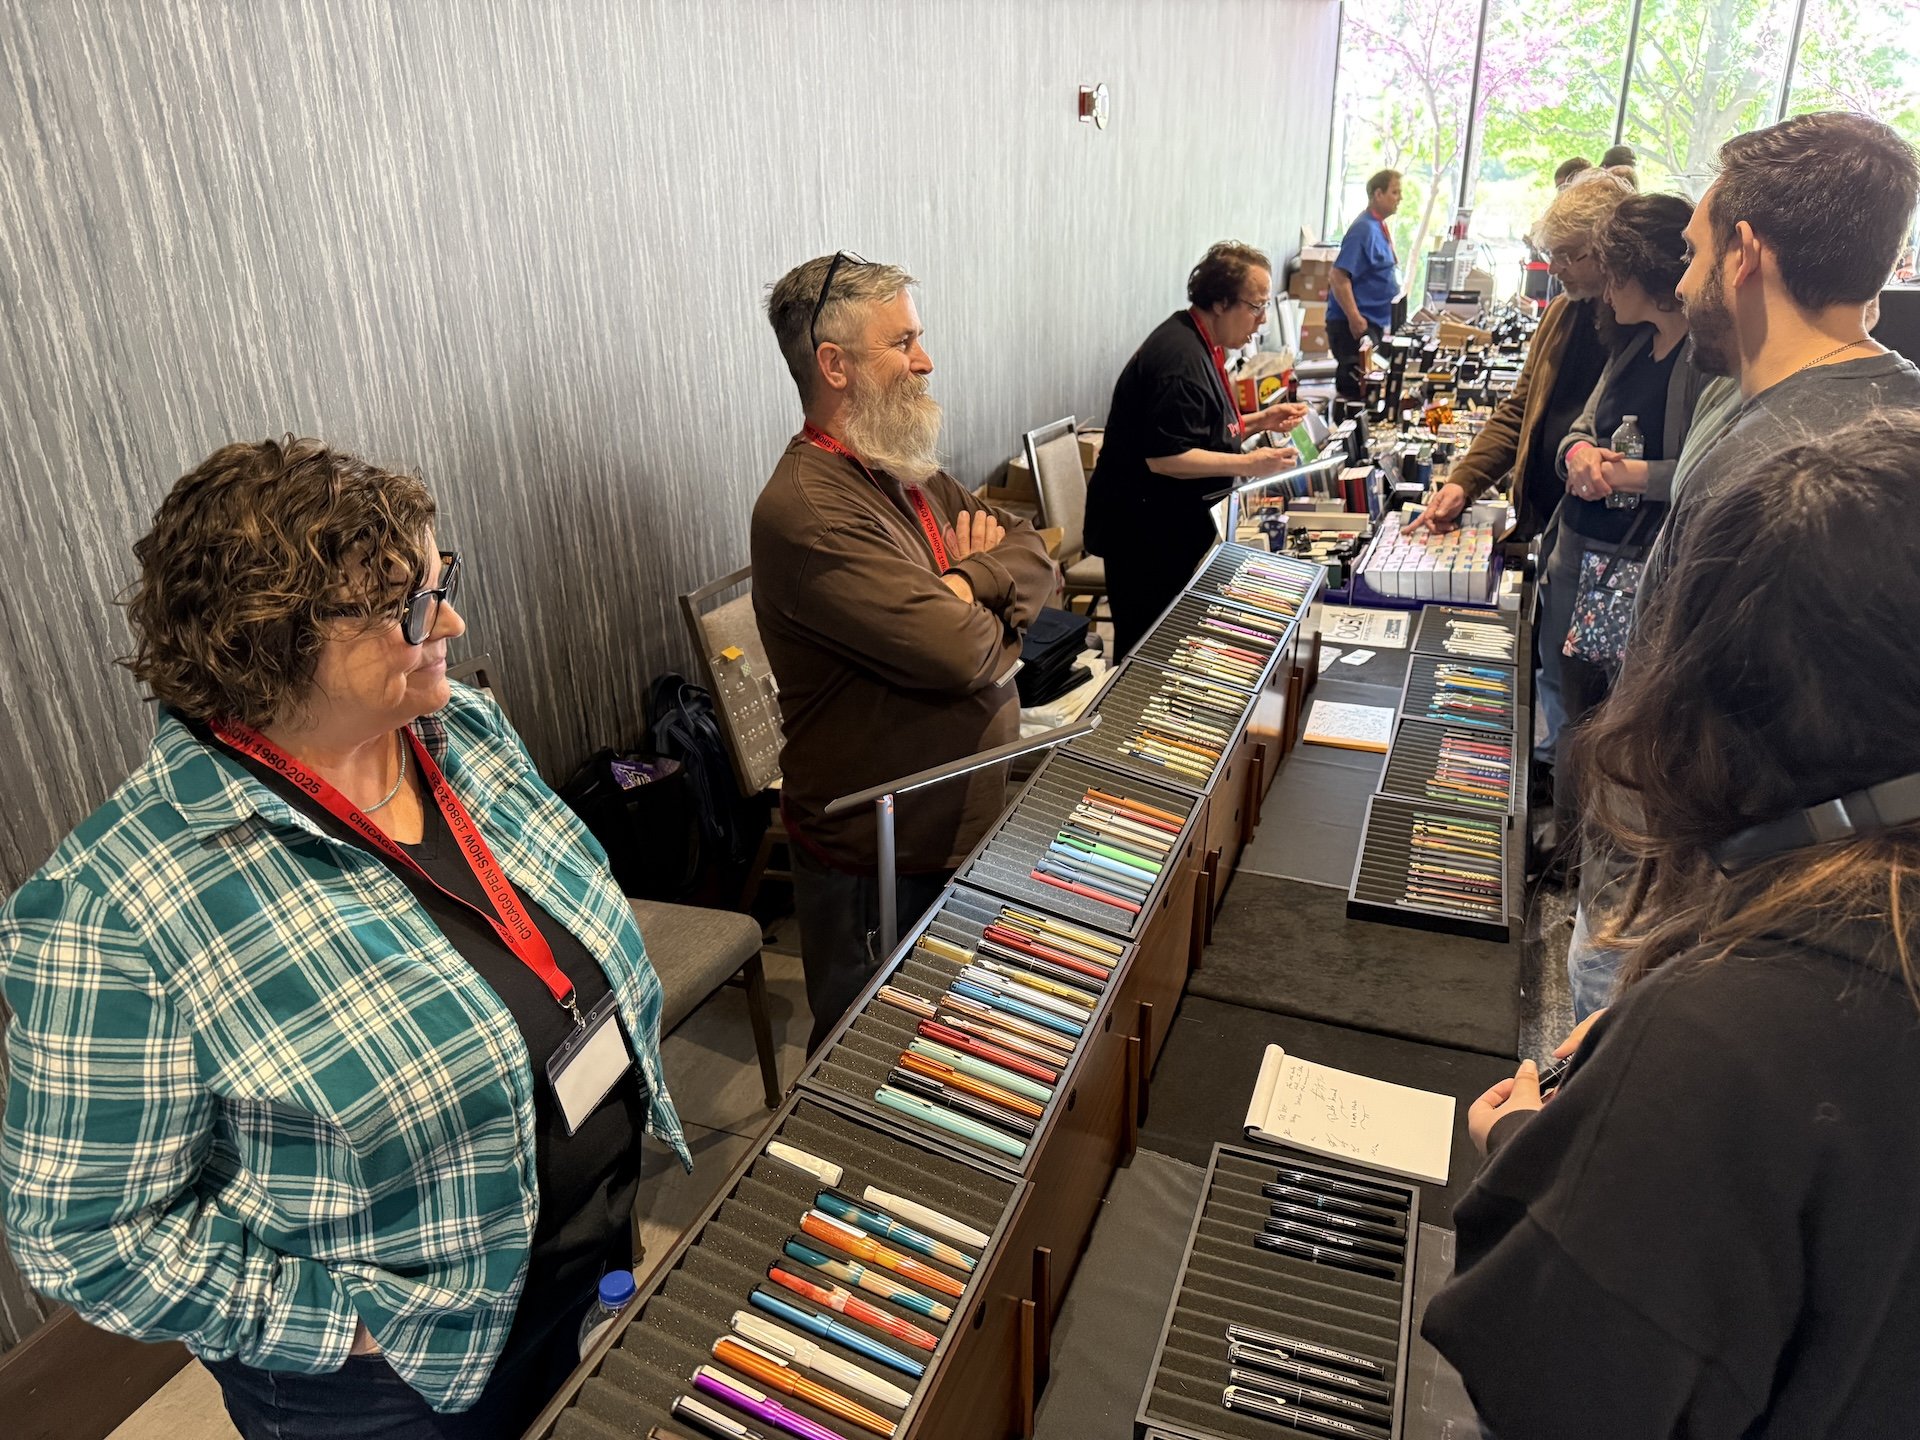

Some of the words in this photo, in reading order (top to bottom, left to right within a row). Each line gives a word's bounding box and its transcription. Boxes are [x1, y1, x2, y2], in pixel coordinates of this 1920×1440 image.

[925, 517, 934, 532] PEN
[930, 532, 943, 555] SHOW
[251, 743, 322, 795] 1980-2025
[348, 811, 398, 854] CHICAGO
[430, 772, 468, 833] 1980-2025
[462, 834, 489, 869] SHOW
[483, 868, 503, 893] PEN
[498, 893, 532, 941] CHICAGO
[1338, 1375, 1361, 1386] STEEL
[1342, 1399, 1364, 1410] STEEL
[1333, 1420, 1356, 1432] STEEL
